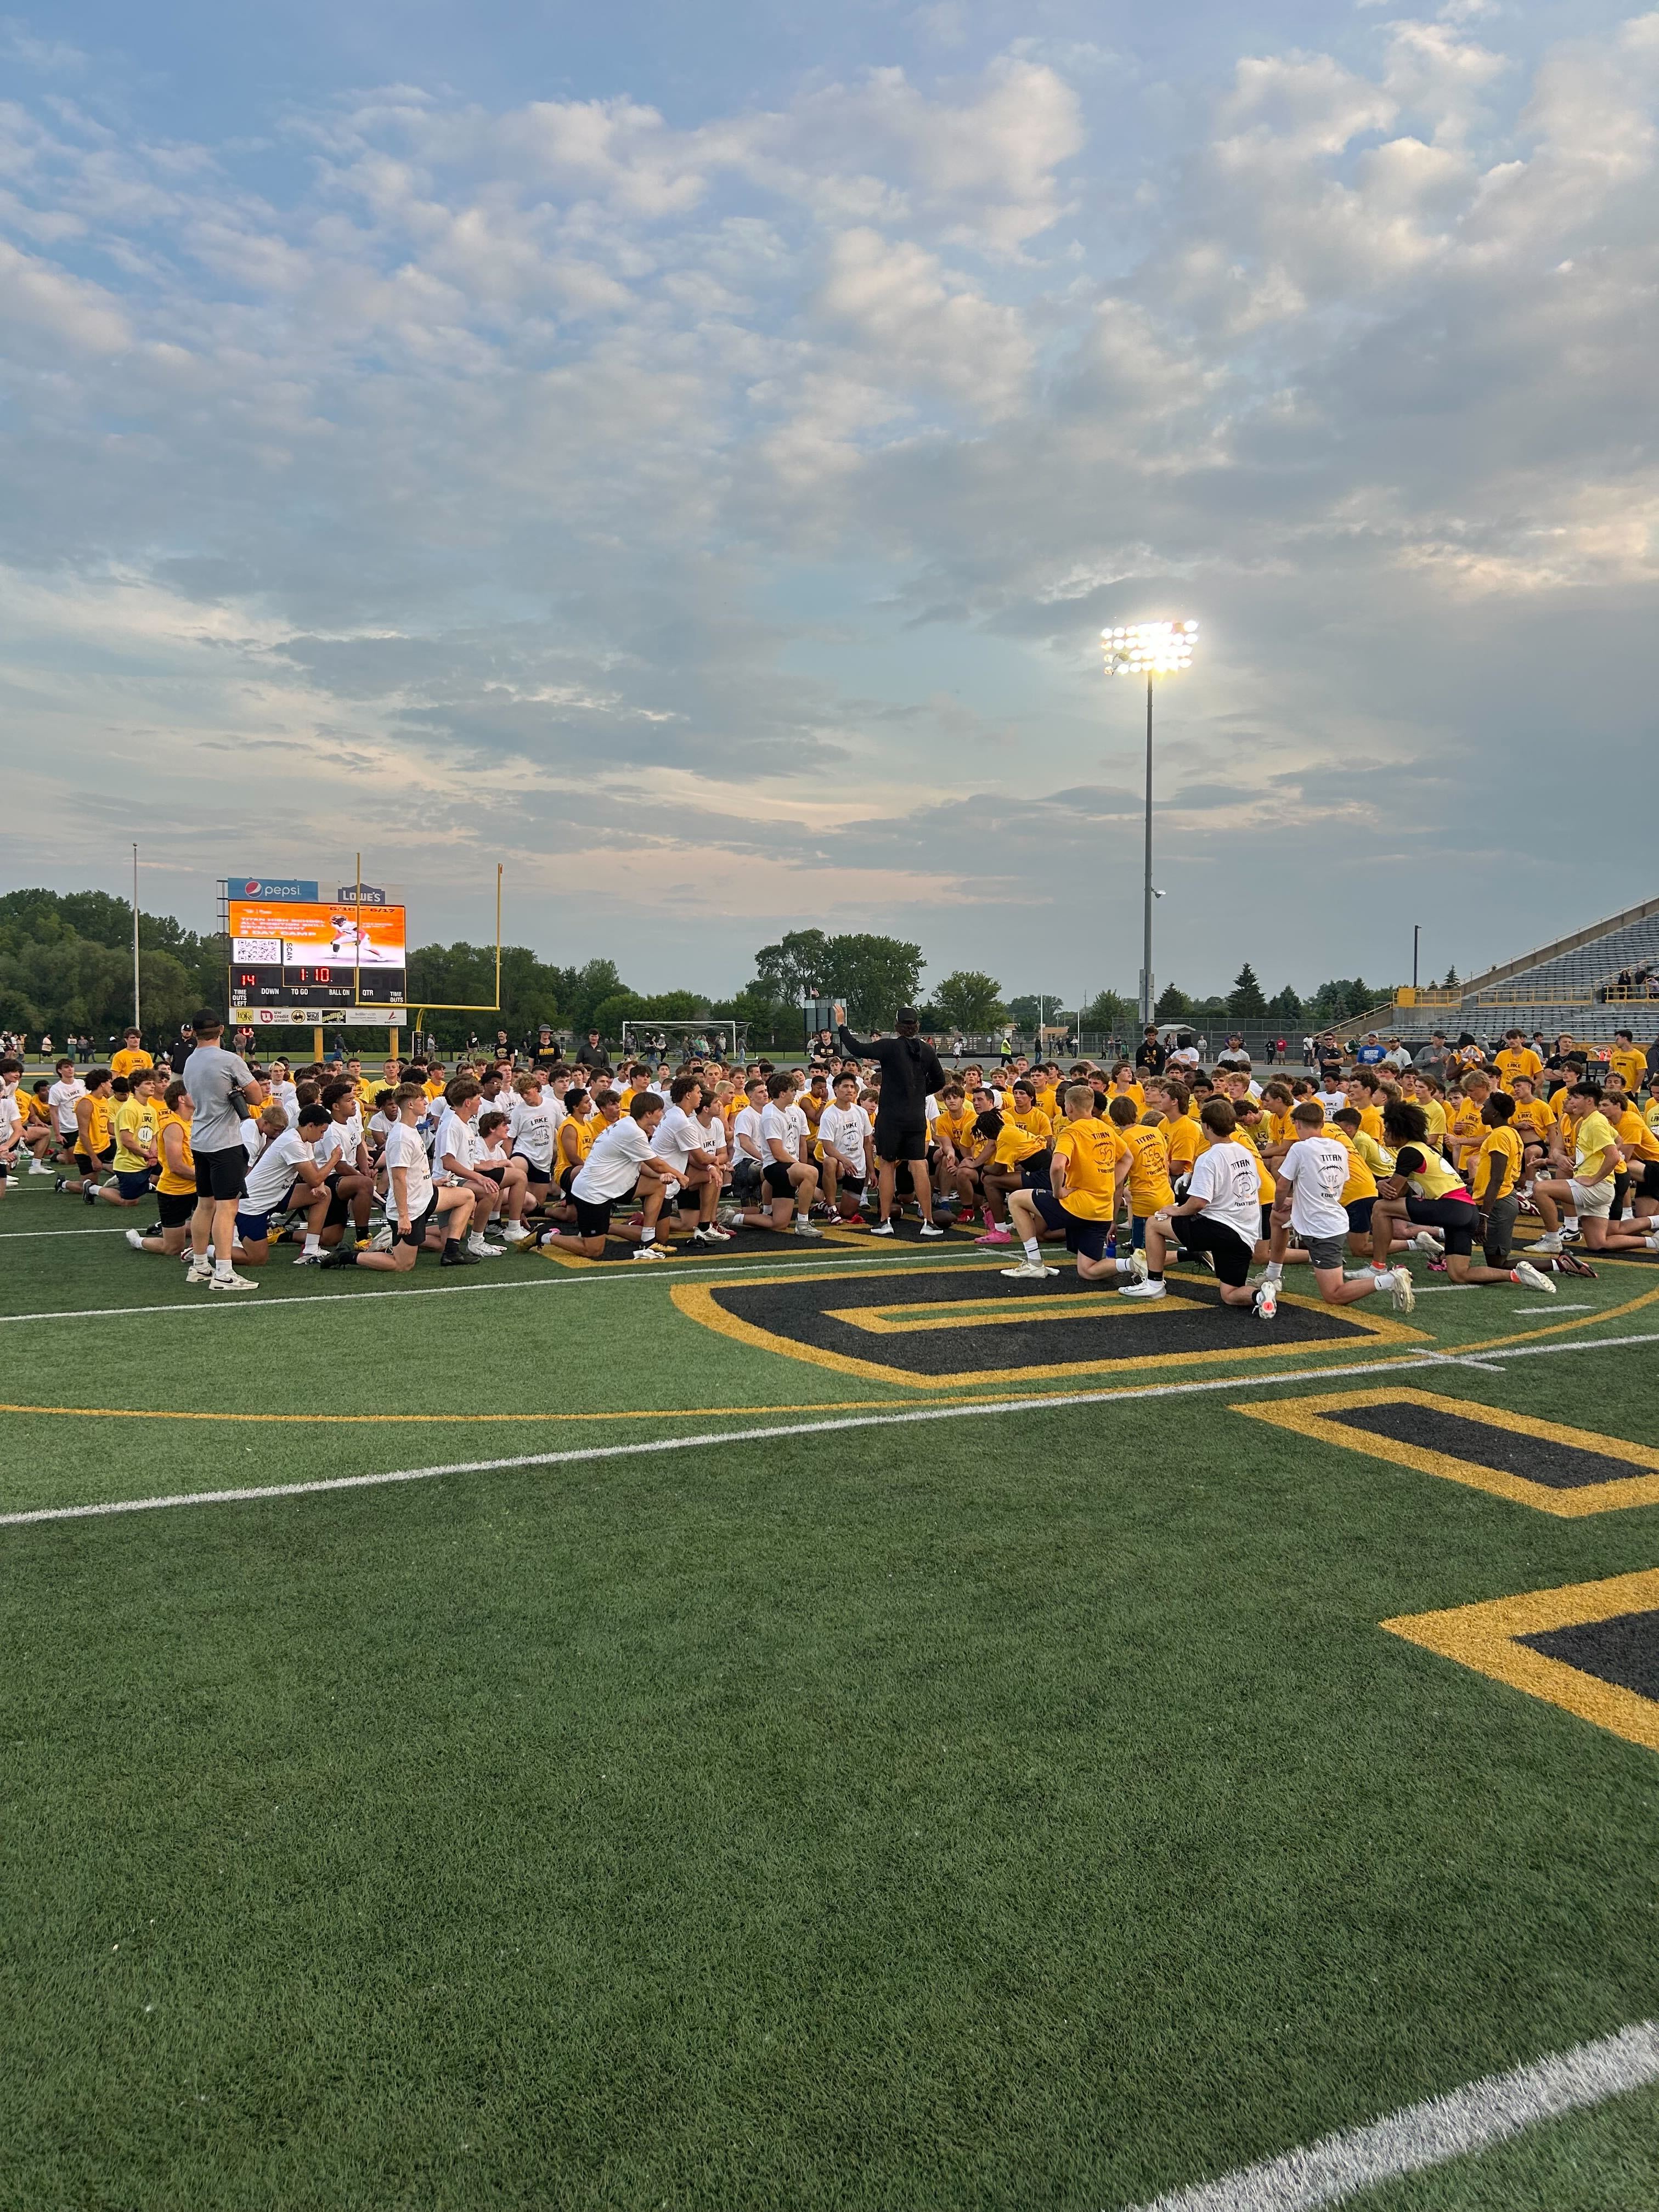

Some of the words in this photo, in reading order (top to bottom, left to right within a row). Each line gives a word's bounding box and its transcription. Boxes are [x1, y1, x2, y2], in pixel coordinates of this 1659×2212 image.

[264, 885, 300, 897] pepsi
[241, 974, 255, 986] 14
[531, 1117, 548, 1126] LAKE
[843, 1122, 857, 1131] LAKE
[1091, 1131, 1110, 1139] TITAN
[1134, 1133, 1156, 1145] TITAN
[703, 1140, 716, 1148] LAKE
[1099, 1146, 1113, 1161] 55
[1231, 1159, 1250, 1170] TITAN
